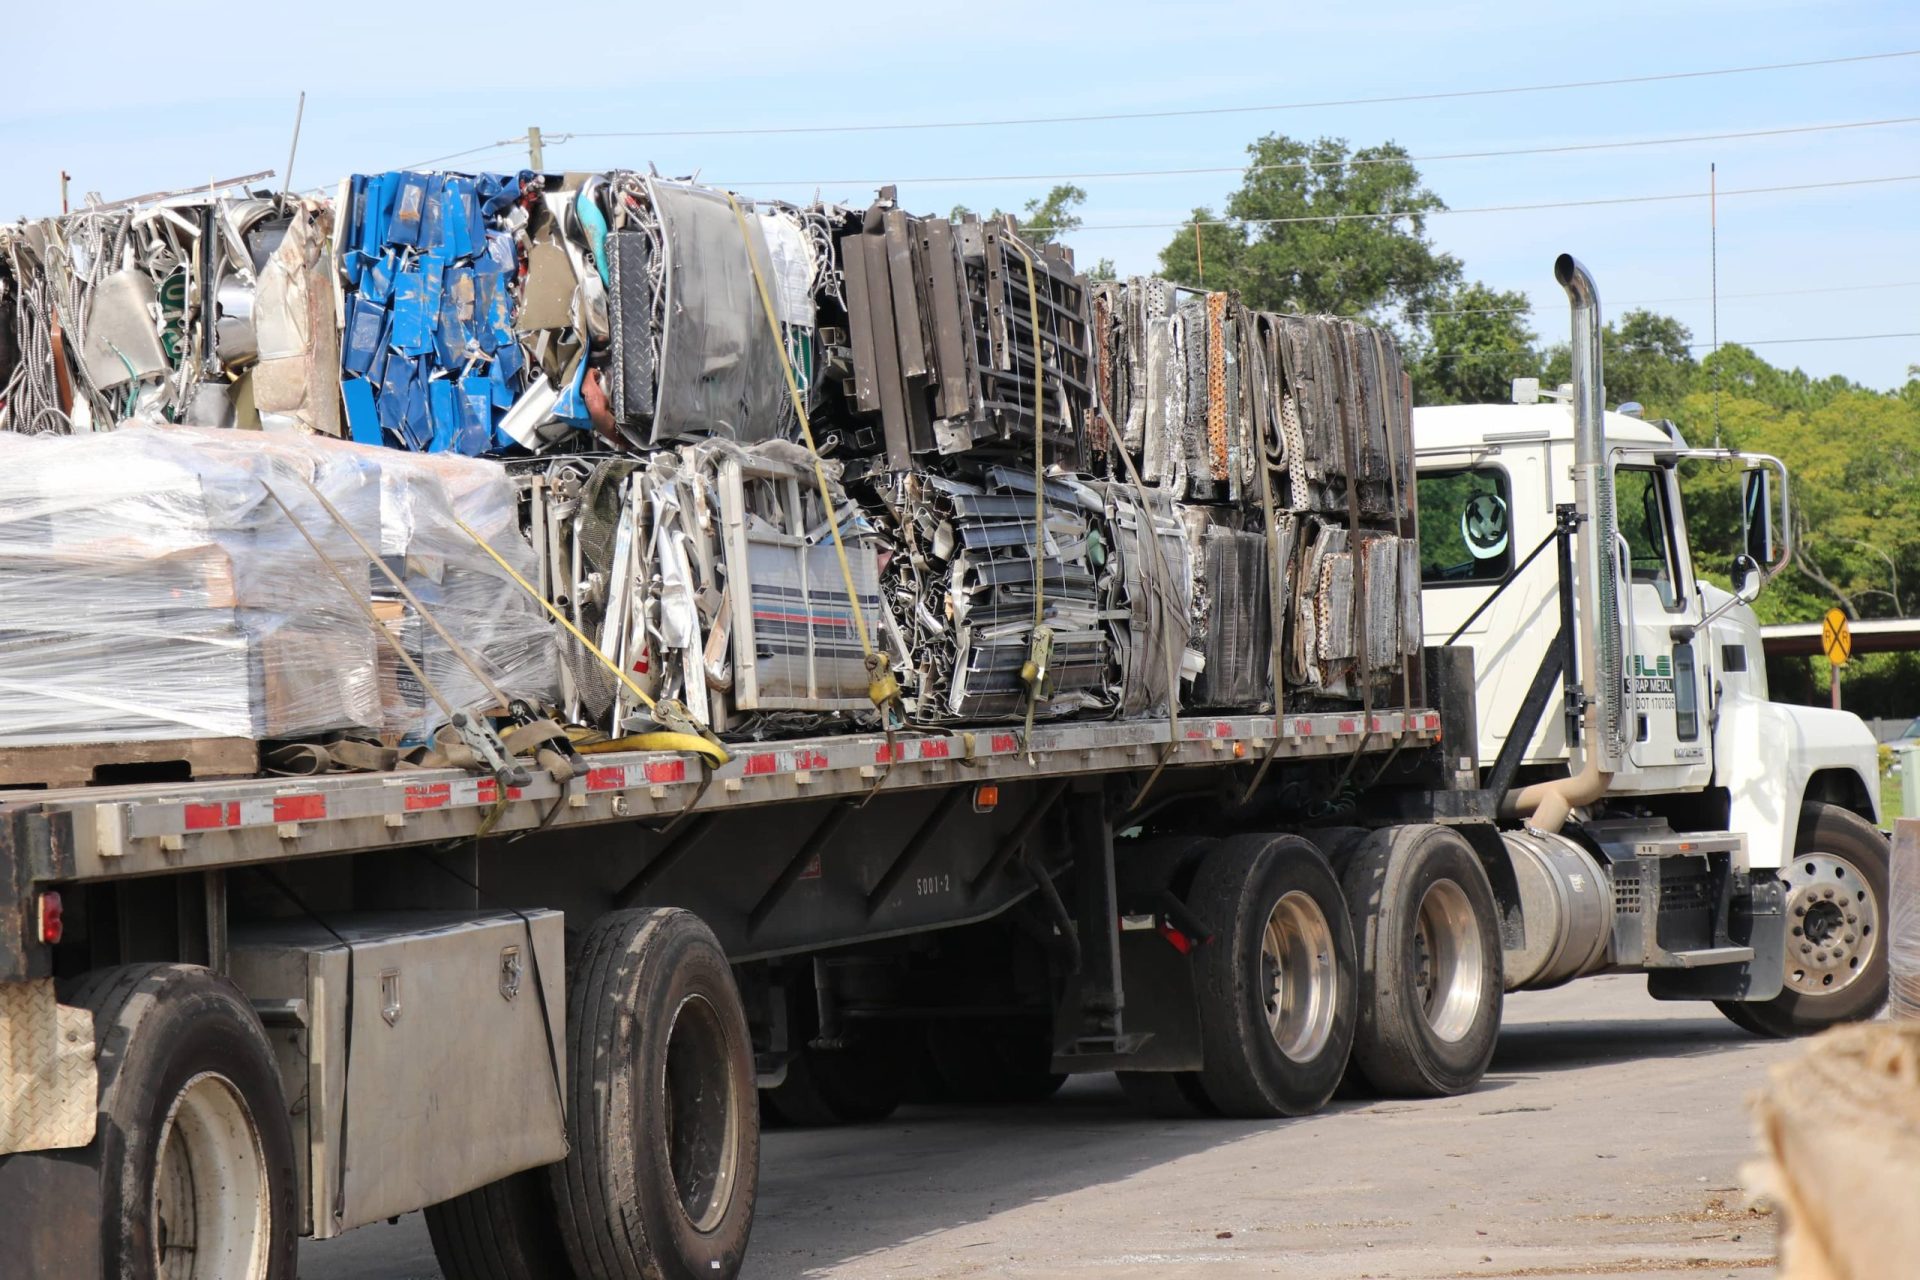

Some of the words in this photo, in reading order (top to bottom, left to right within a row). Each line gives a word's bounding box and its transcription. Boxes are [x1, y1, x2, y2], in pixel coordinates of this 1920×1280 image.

[1626, 655, 1671, 676] GLE
[1626, 679, 1649, 692] SRAP
[1650, 679, 1672, 692] METAL
